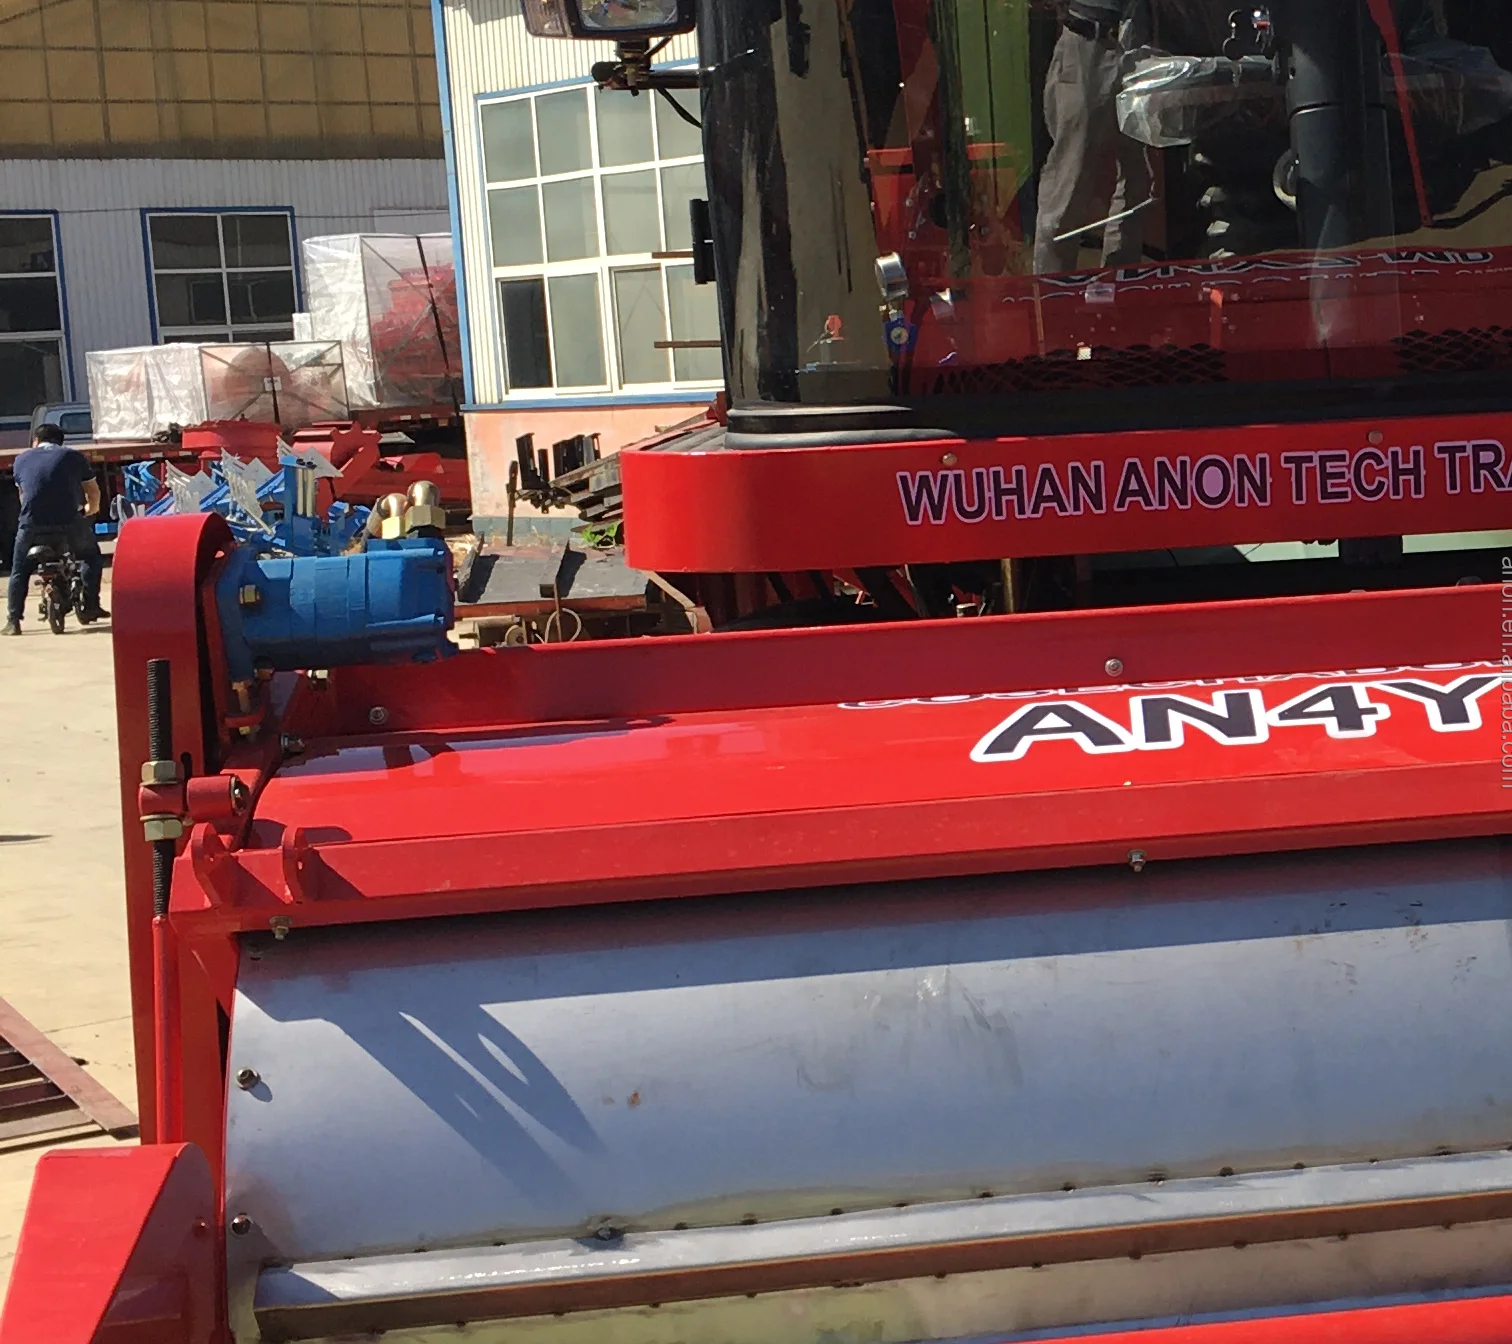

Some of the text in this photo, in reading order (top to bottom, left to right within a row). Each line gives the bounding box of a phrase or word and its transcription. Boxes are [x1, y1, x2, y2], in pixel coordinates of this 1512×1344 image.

[897, 459, 1106, 525] WUHAN
[1114, 453, 1272, 513] ANON
[1281, 443, 1425, 505] TECH
